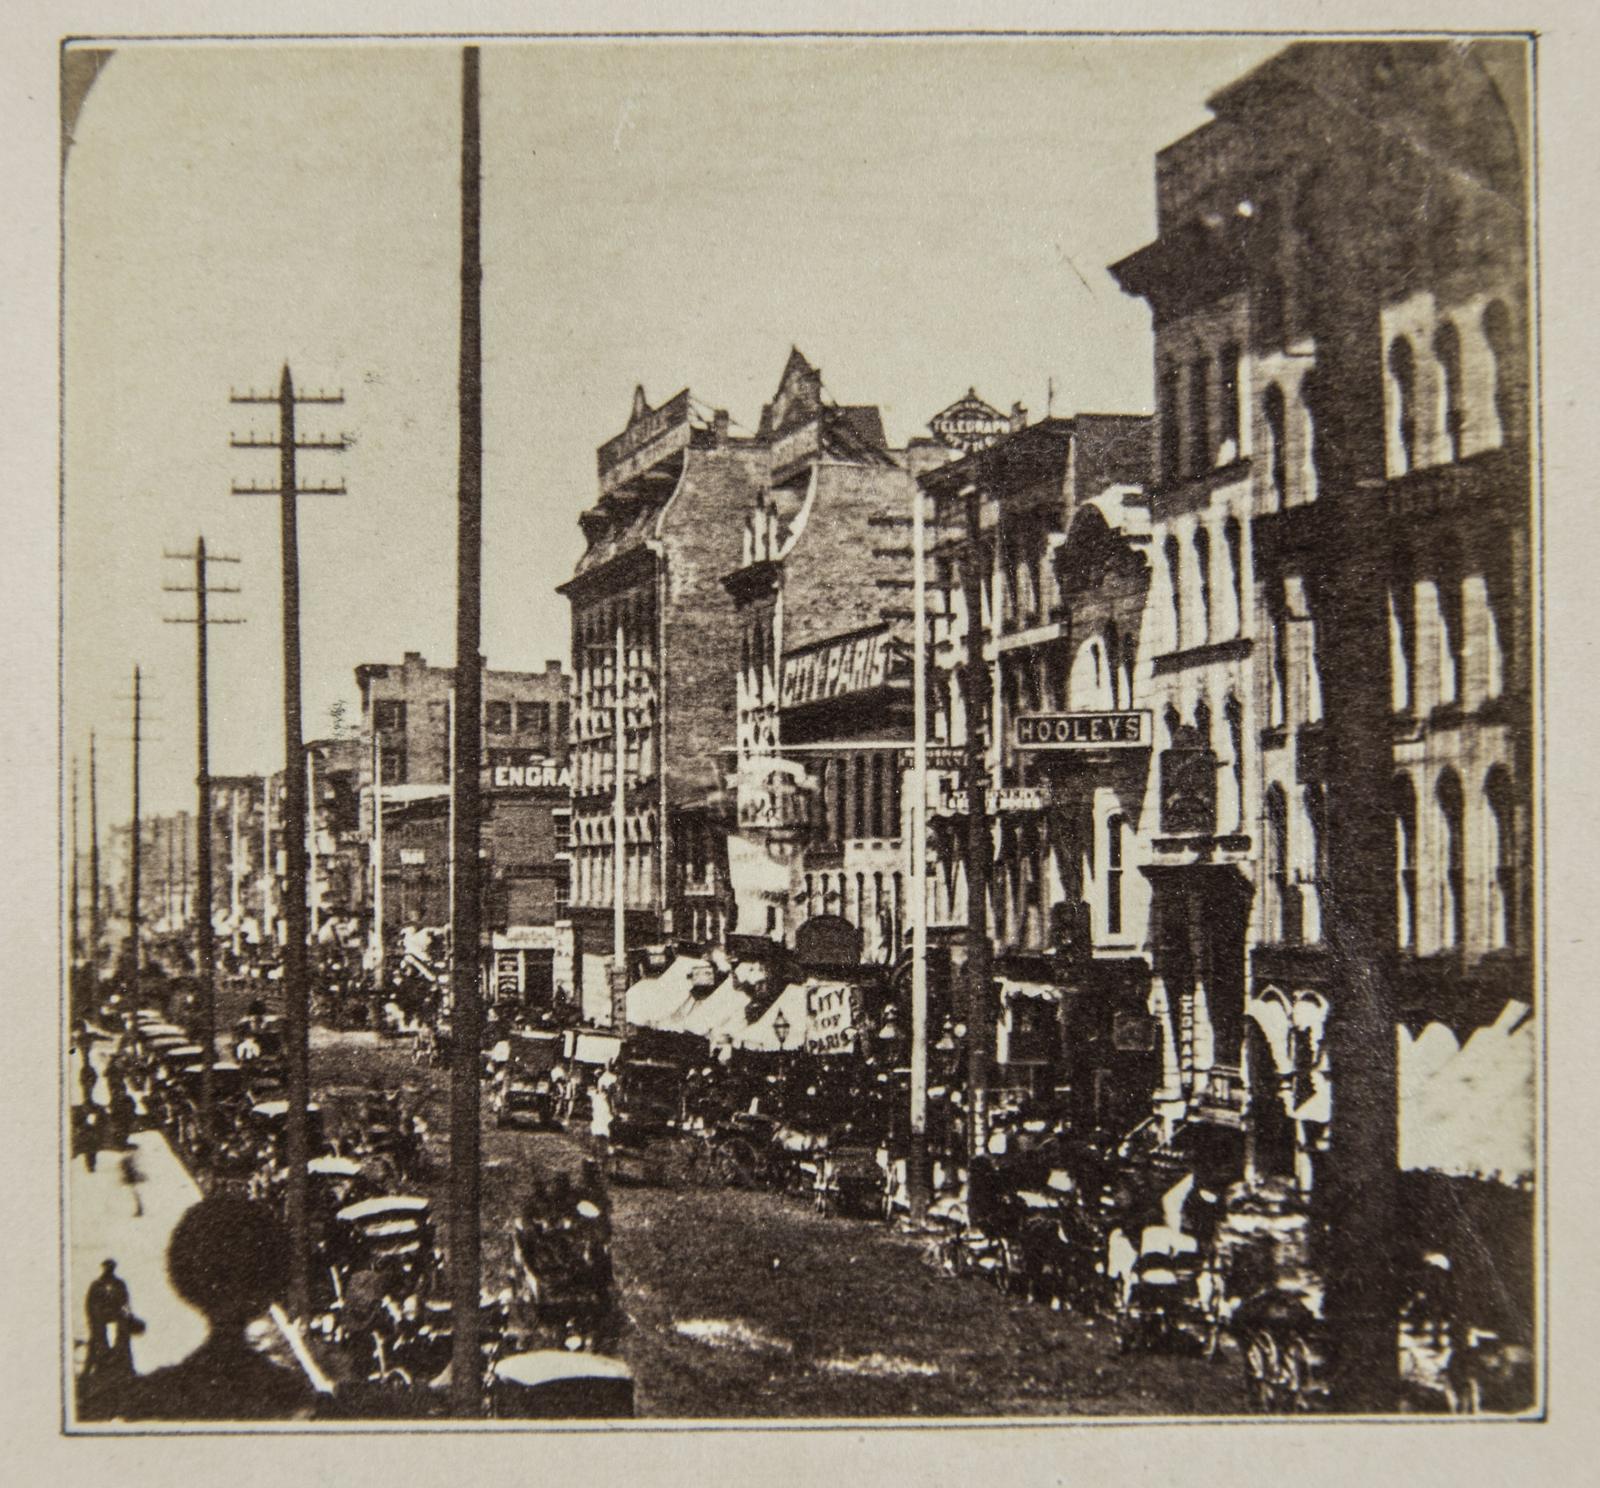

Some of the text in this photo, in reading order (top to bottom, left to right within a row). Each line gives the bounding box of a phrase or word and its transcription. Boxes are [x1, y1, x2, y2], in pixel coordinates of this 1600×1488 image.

[823, 632, 890, 698] PARIS
[1020, 718, 1140, 743] HOOLEYS
[806, 987, 846, 1017] CITY
[821, 1014, 841, 1028] OF
[808, 1027, 857, 1052] PARIS
